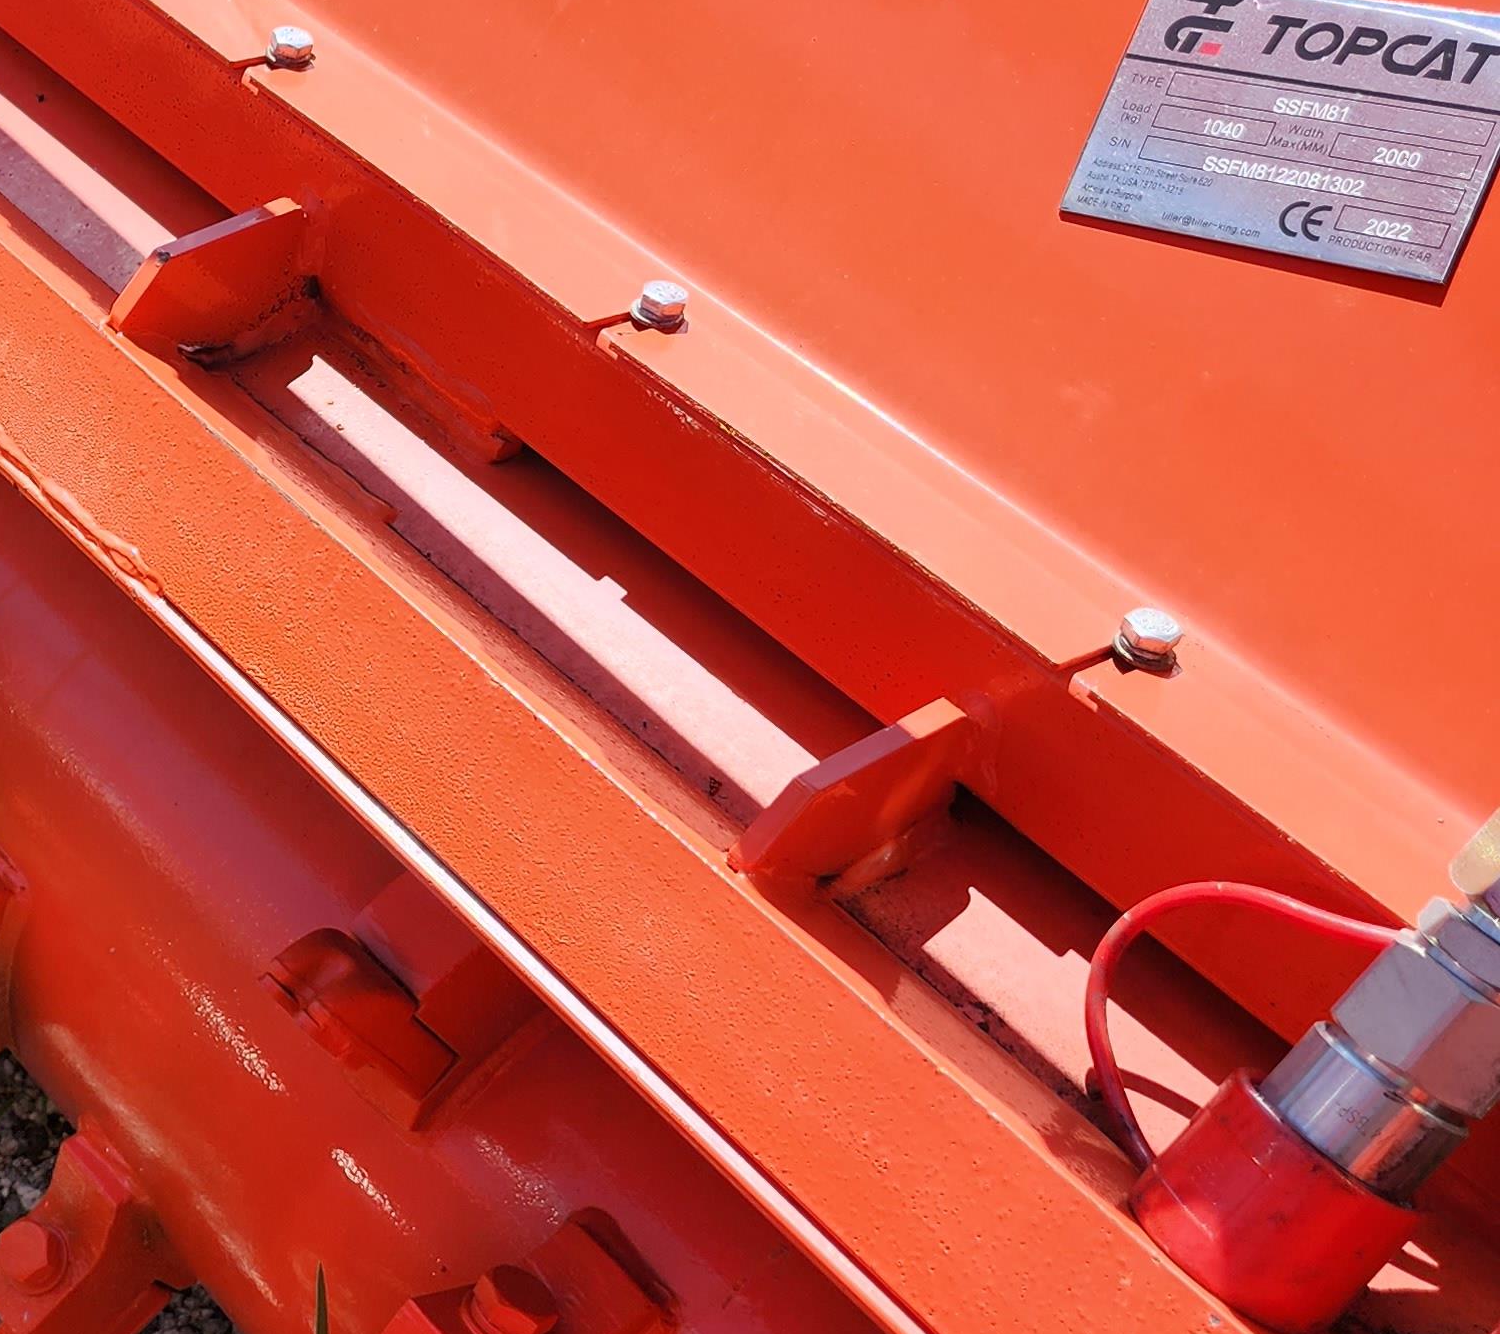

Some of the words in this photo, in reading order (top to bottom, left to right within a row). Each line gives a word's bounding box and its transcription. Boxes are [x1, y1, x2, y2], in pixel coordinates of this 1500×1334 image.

[1261, 14, 1500, 85] TOPCAT
[1131, 73, 1165, 88] TYPE
[1122, 99, 1153, 113] Load
[1272, 97, 1350, 123] SSFM81
[1202, 117, 1245, 139] 1040
[1288, 123, 1325, 139] Width
[1108, 136, 1132, 149] S/N
[1269, 135, 1329, 155] Max(MM)
[1372, 147, 1422, 169] 2000
[1202, 155, 1365, 196] SSFM8122081302
[1278, 200, 1333, 242] CE
[1363, 218, 1412, 241] 2022
[1327, 235, 1401, 256] PRODUCTION
[1402, 249, 1432, 263] YEAR
